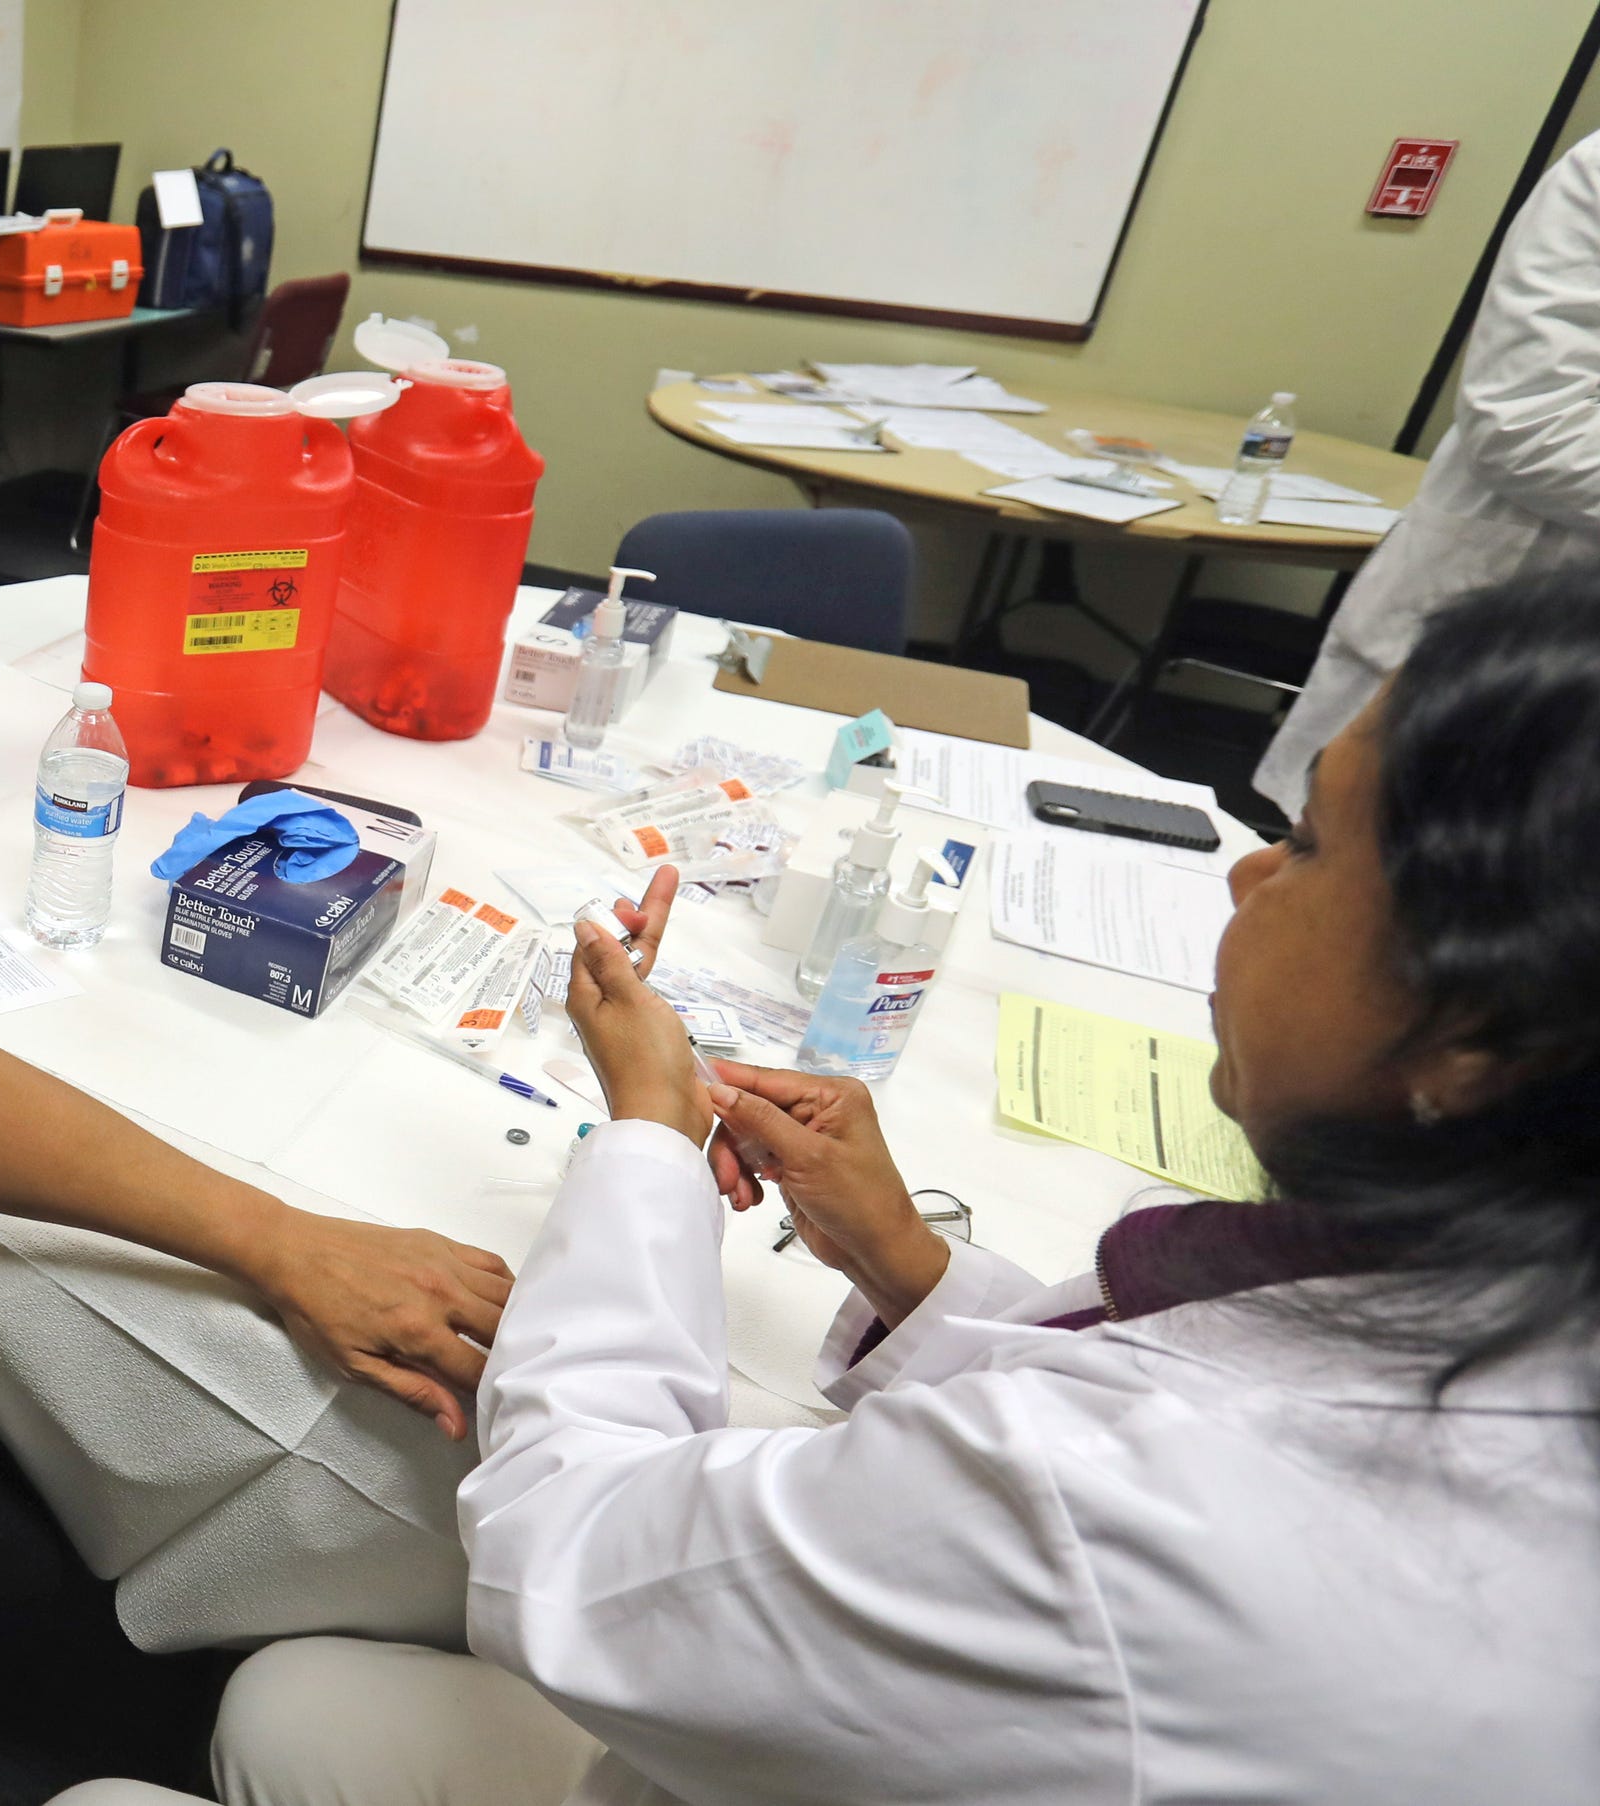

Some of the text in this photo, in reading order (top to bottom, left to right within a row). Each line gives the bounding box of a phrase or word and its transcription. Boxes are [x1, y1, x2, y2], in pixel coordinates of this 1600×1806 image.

[54, 796, 87, 809] KIRKLAND
[70, 815, 93, 826] water
[194, 840, 266, 891] Better Touch
[177, 893, 256, 931] Better Touch
[325, 893, 354, 919] cabvi
[174, 914, 233, 940] EXAMINATION GLOVES
[175, 906, 251, 937] BLUE NITRILE POWDER FREE
[180, 957, 204, 974] cabvi
[269, 969, 291, 984] 807.3
[292, 984, 313, 1008] M
